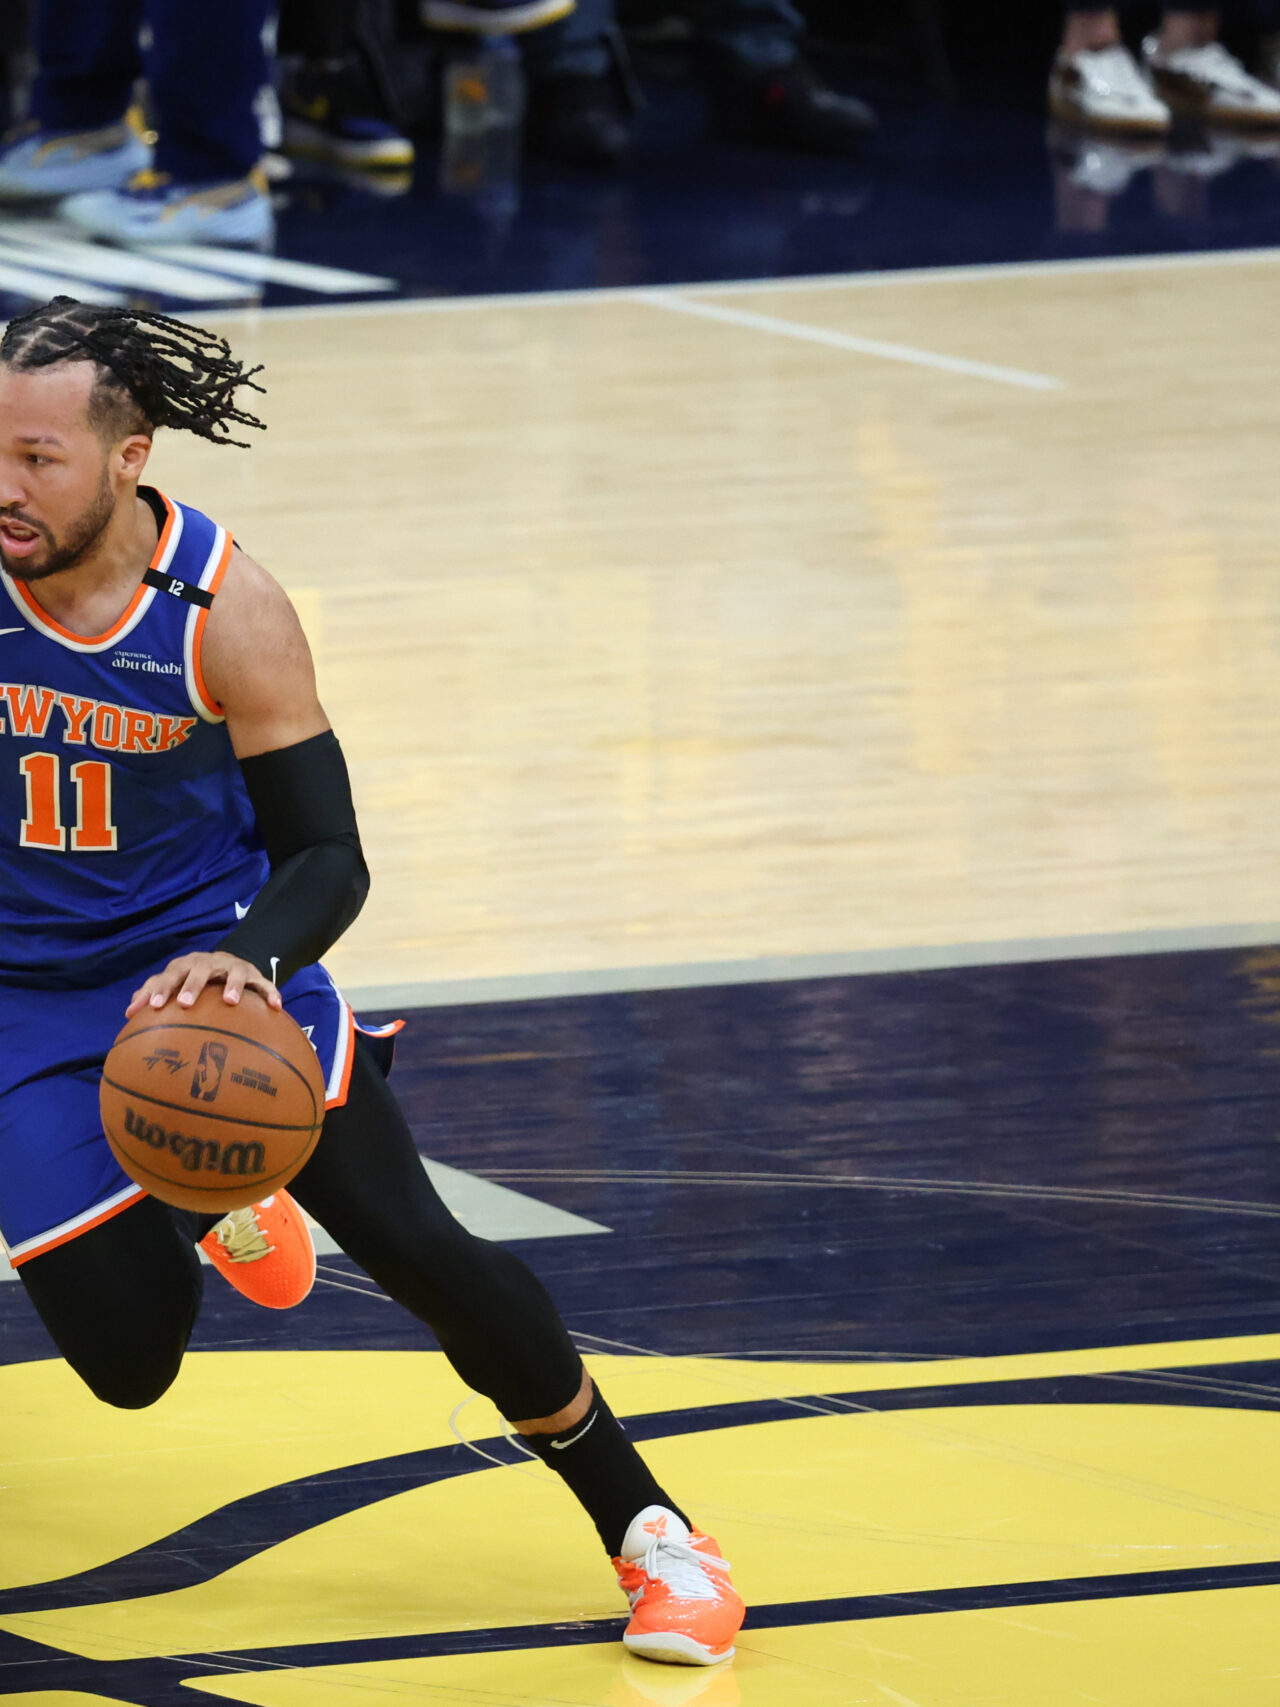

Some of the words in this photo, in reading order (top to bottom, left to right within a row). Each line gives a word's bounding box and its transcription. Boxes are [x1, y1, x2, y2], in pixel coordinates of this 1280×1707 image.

[168, 578, 185, 597] 12
[111, 657, 139, 671] abu
[141, 660, 183, 676] dhabi
[58, 691, 198, 753] YORK
[19, 751, 118, 852] 11
[124, 1106, 266, 1175] Wilson
